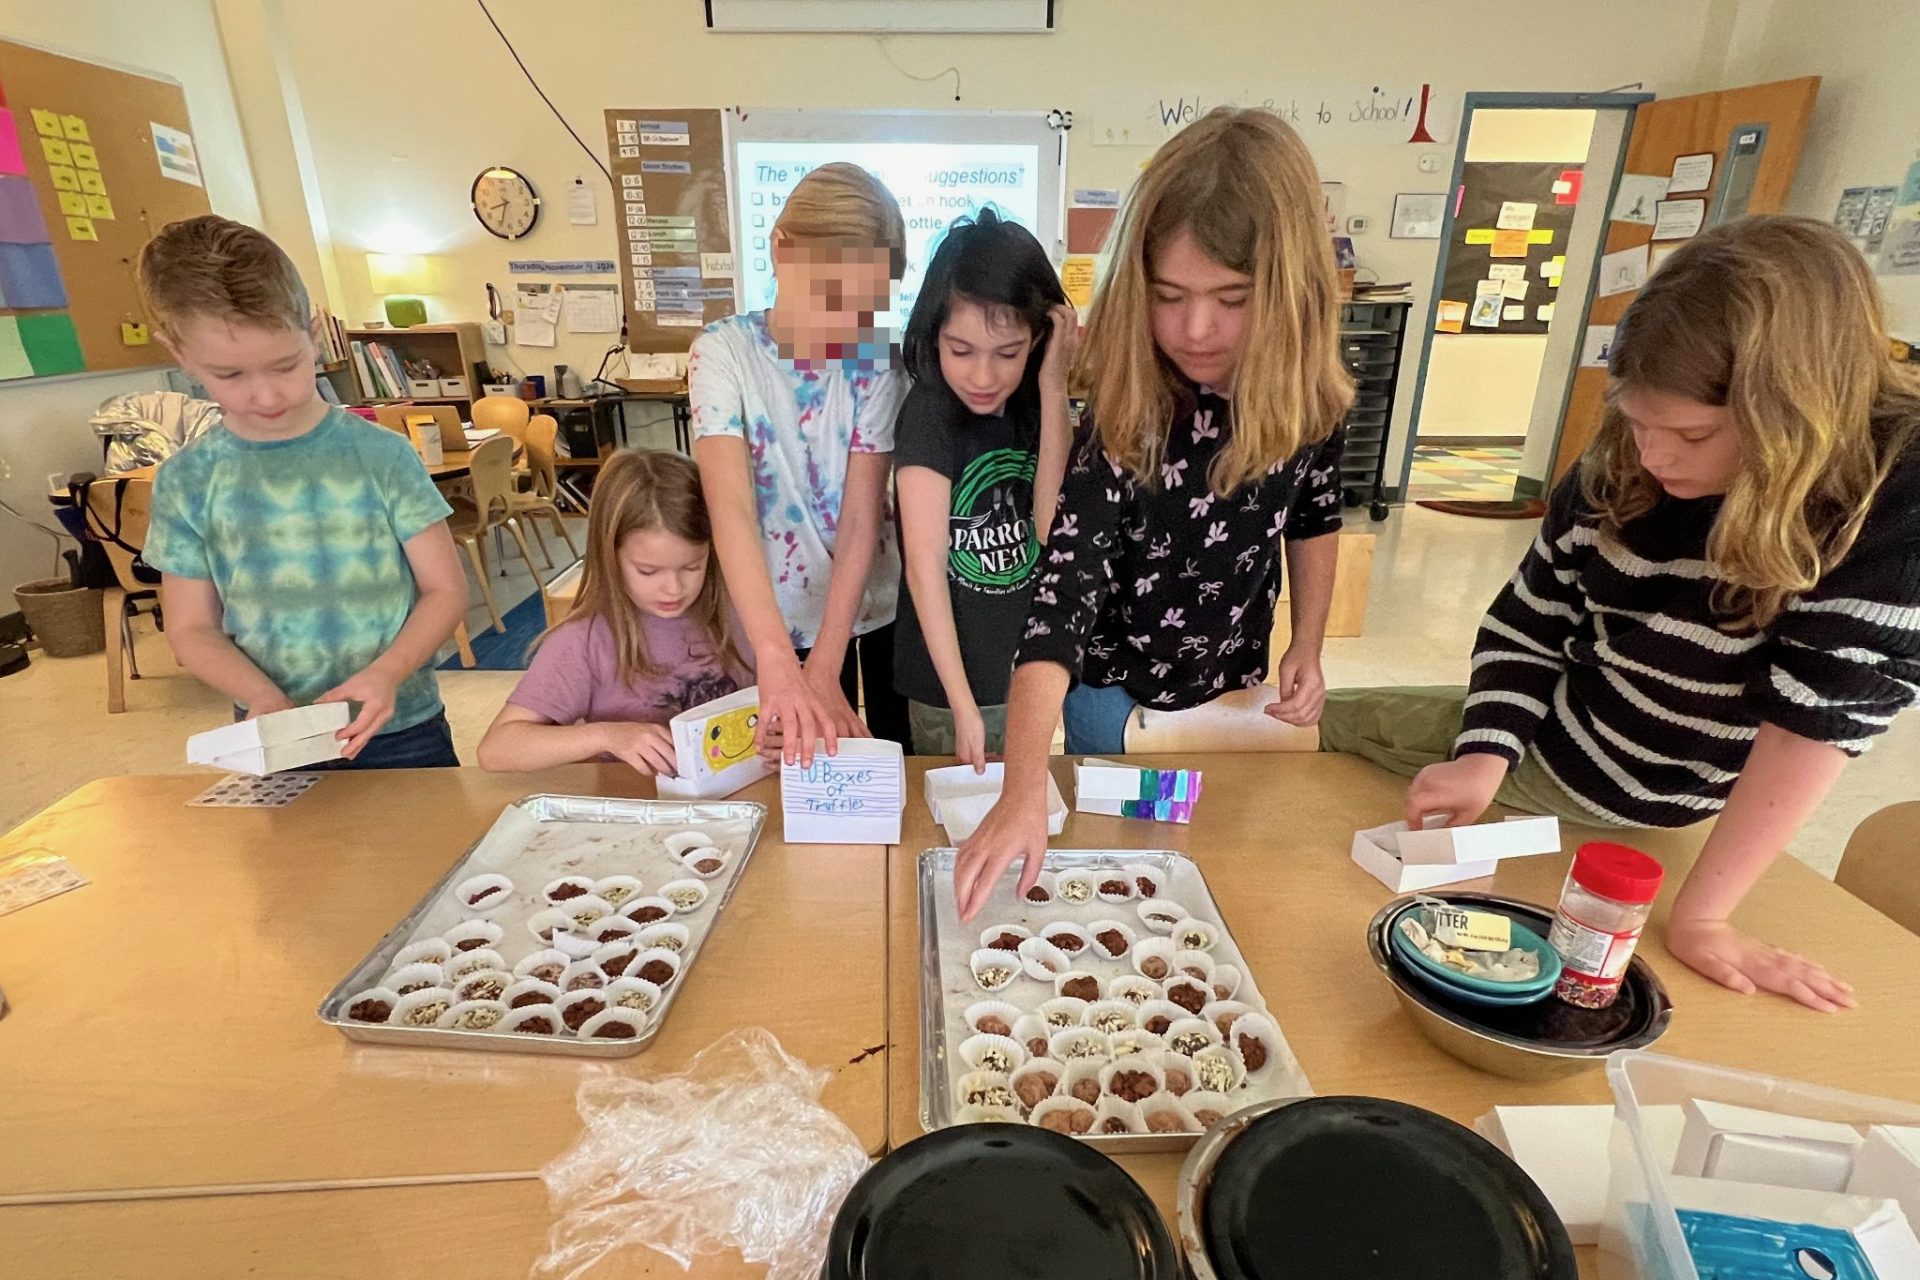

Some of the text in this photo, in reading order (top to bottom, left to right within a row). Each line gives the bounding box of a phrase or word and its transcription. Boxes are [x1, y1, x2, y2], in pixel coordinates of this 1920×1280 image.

[1317, 102, 1332, 124] to
[1349, 97, 1412, 124] School!
[757, 165, 788, 182] The
[939, 194, 973, 208] hook
[954, 519, 1030, 551] PARRO
[979, 542, 1028, 575] NEST
[823, 761, 874, 784] Boxes
[806, 797, 865, 812] Truffles
